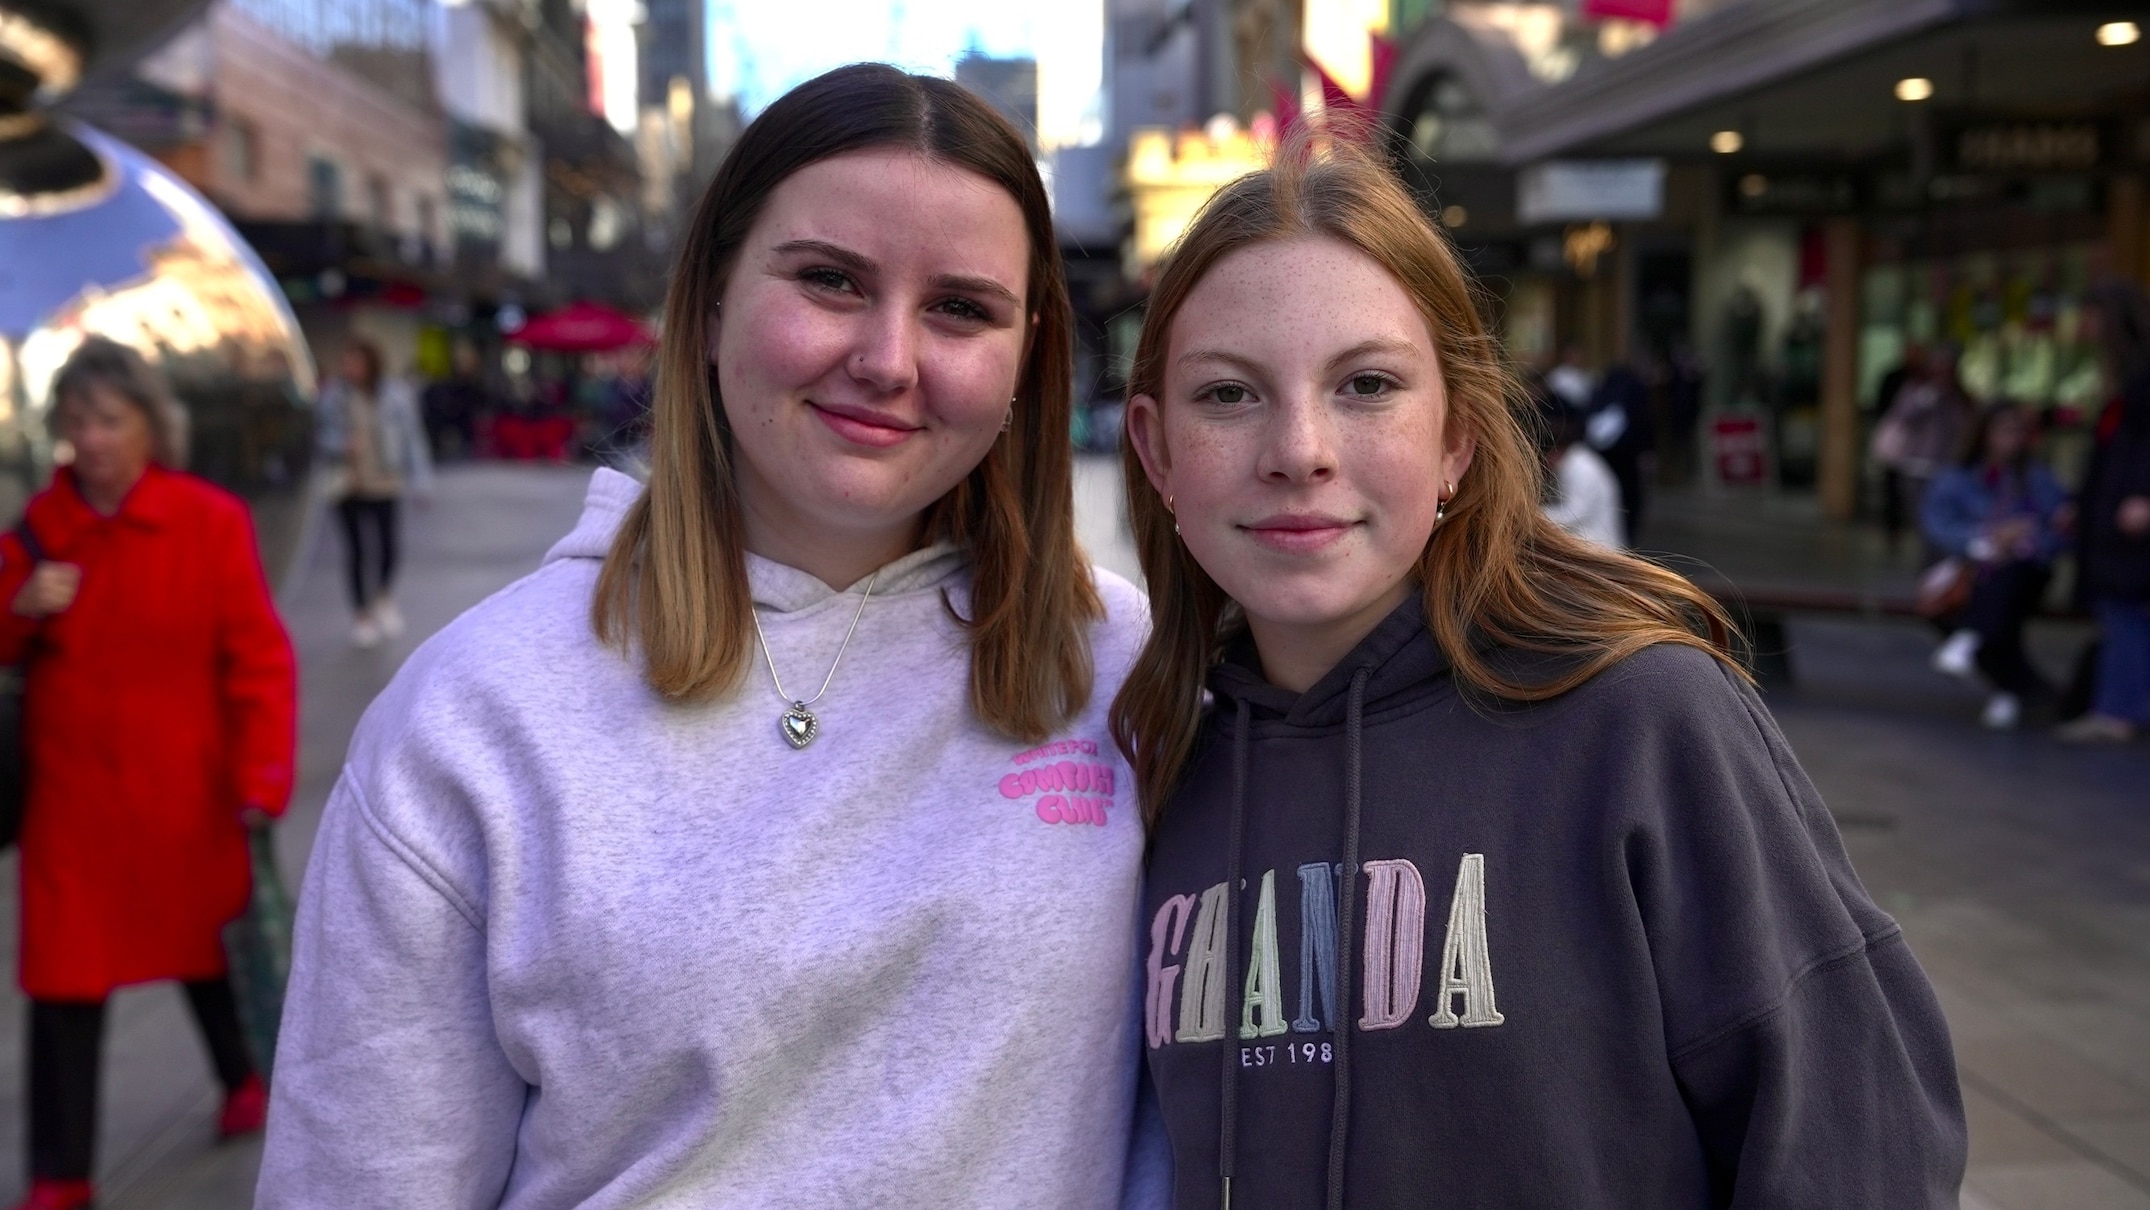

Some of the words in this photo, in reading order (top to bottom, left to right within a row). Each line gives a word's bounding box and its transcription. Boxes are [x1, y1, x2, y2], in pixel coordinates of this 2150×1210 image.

[1145, 852, 1505, 1050] GHANDA
[1241, 1045, 1276, 1067] EST
[1287, 1042, 1333, 1064] 198
